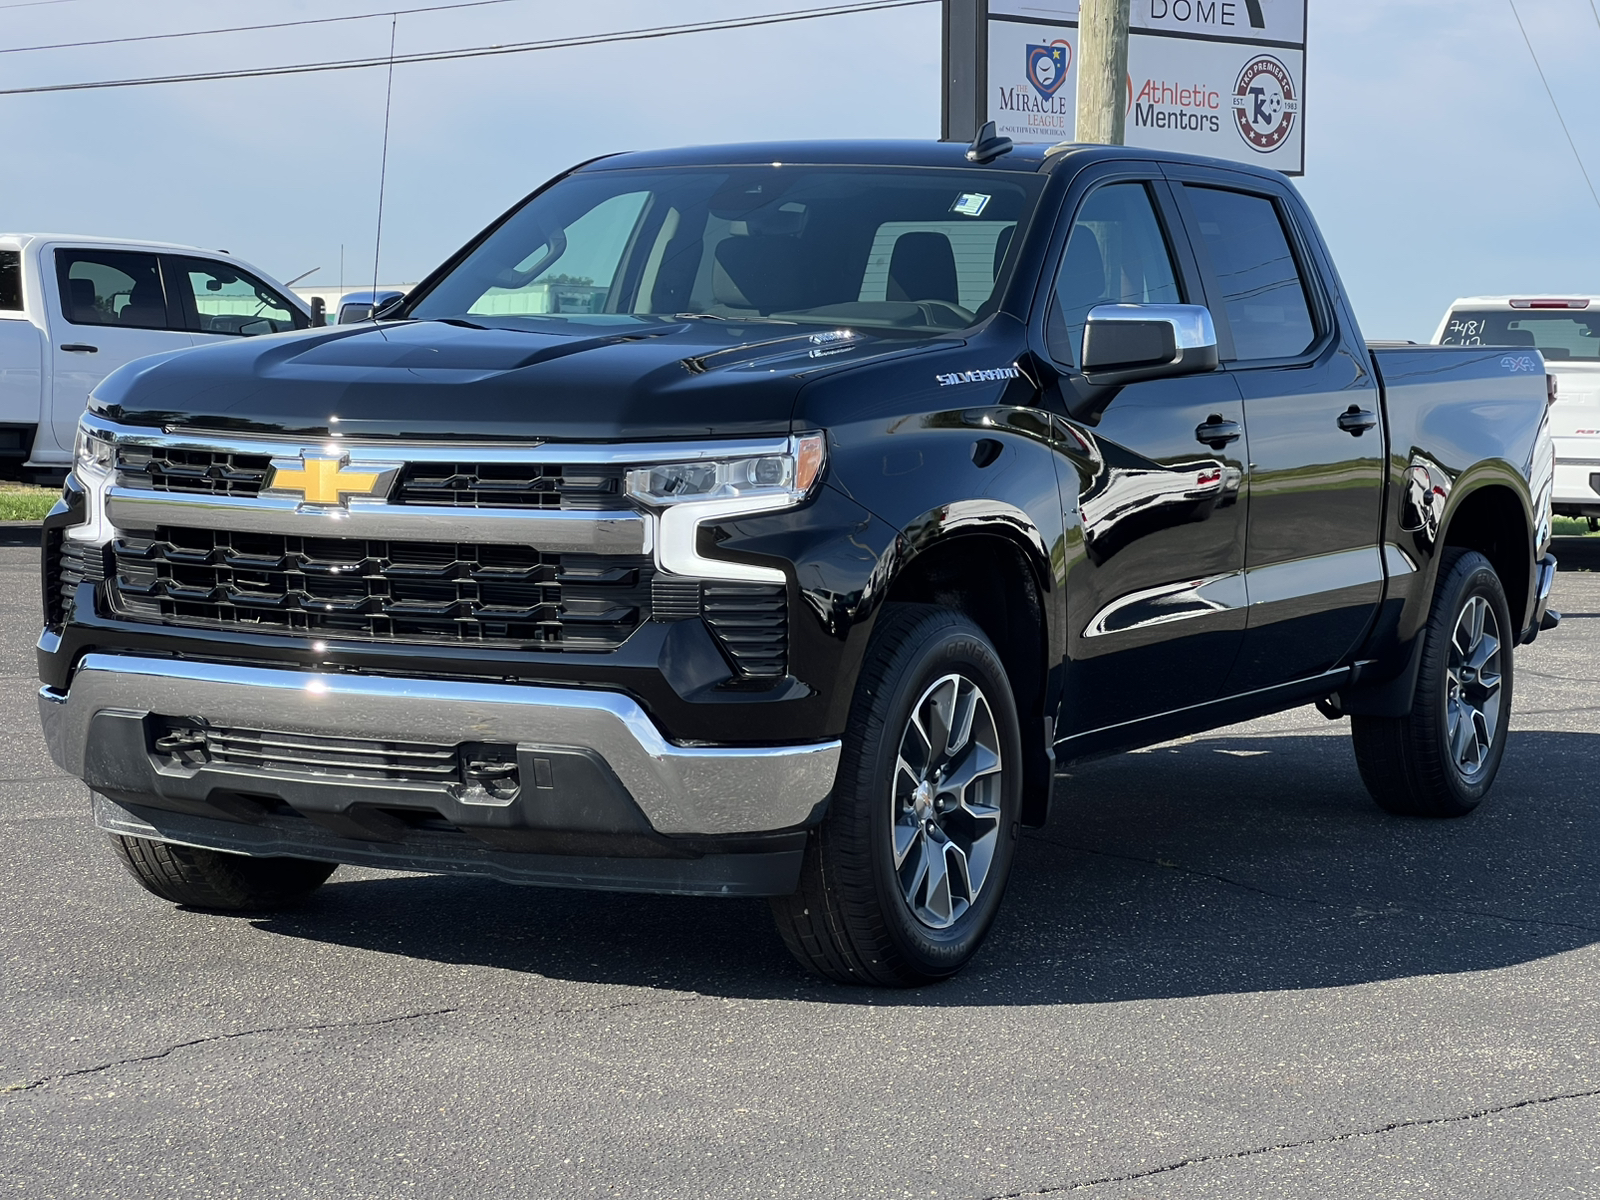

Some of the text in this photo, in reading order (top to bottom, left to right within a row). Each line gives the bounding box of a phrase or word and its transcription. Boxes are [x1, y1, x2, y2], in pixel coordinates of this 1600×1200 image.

[1151, 0, 1235, 26] DOME
[1240, 62, 1290, 93] TKO PREMIER SC
[1016, 84, 1028, 93] THE
[1136, 78, 1220, 110] Athletic
[999, 86, 1067, 115] MIRACLE
[1233, 97, 1245, 106] EST.
[1284, 102, 1298, 111] 1983
[1027, 114, 1065, 128] LEAGUE
[1135, 102, 1220, 133] Mentors
[1005, 126, 1040, 135] SOUTHWEST
[1449, 319, 1486, 337] 7481
